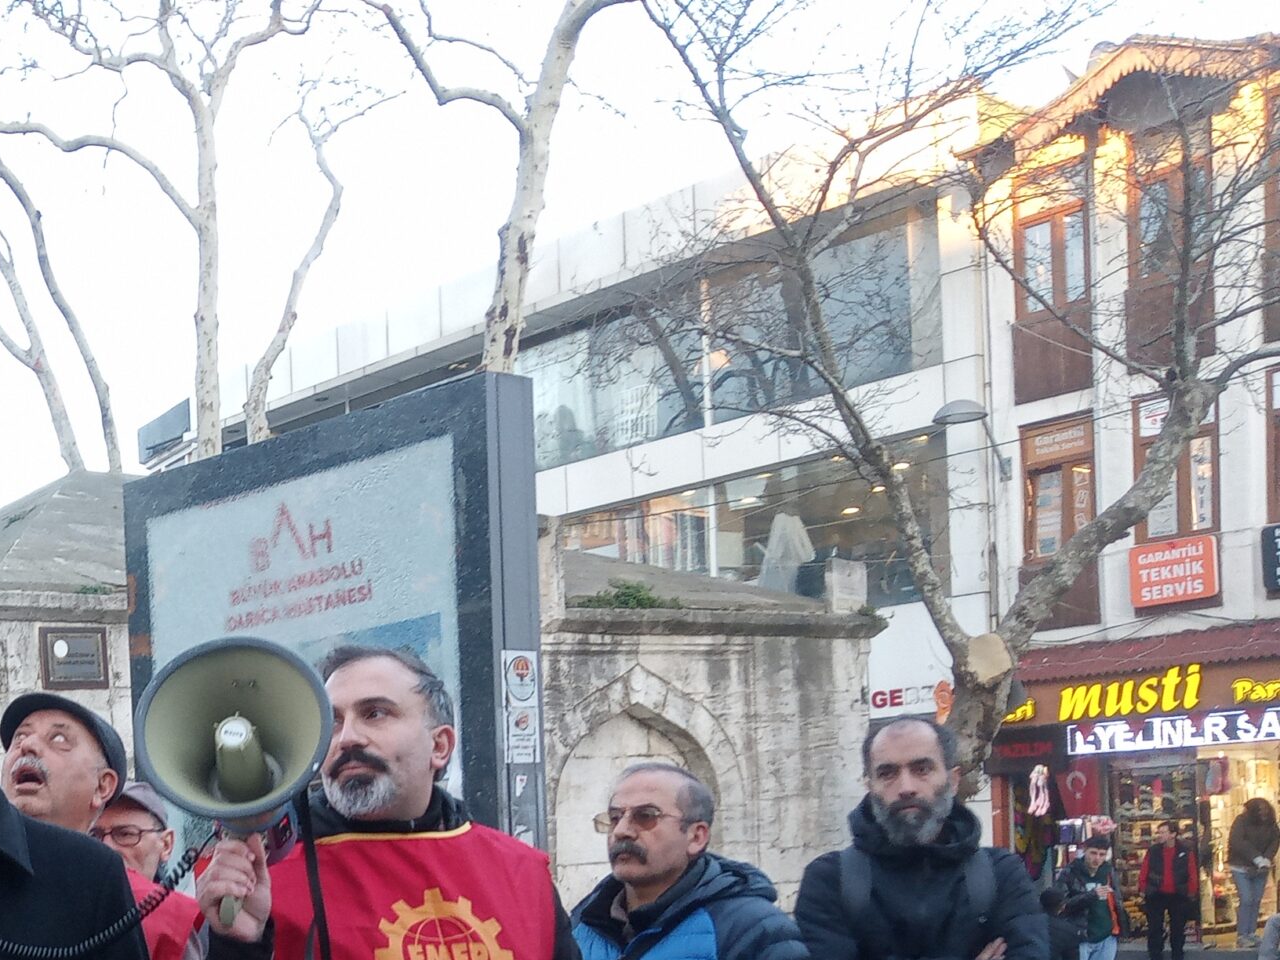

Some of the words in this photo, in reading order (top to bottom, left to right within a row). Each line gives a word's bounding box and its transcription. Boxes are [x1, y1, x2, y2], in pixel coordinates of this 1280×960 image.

[1137, 542, 1204, 565] GARANTİLİ
[1138, 559, 1204, 583] TEKNİK
[1140, 579, 1204, 601] SERVİS
